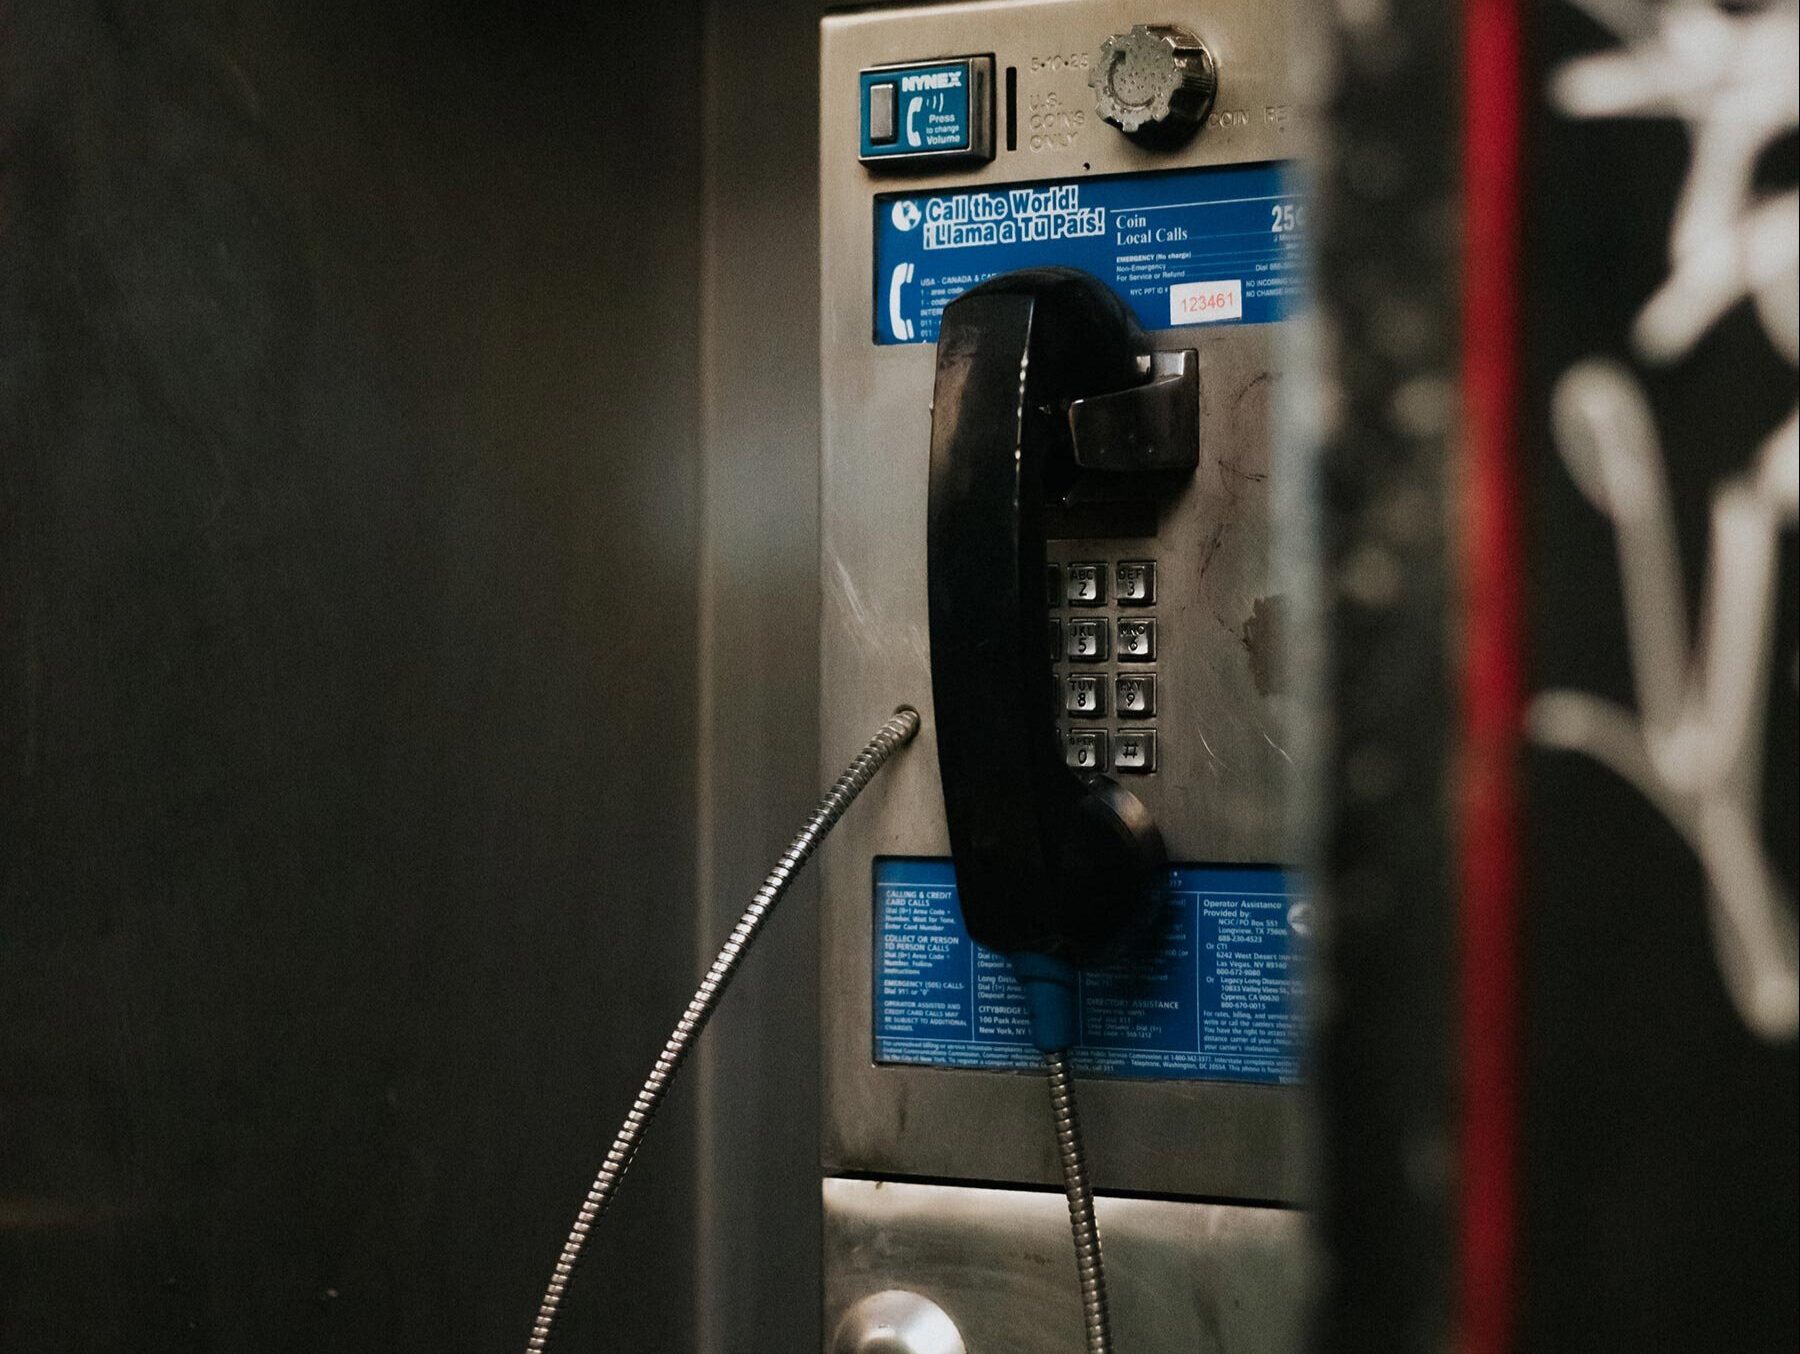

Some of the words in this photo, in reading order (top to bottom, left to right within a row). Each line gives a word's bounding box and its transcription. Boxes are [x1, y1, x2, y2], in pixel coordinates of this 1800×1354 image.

[902, 71, 962, 92] NYNEX
[928, 114, 955, 124] Press
[1208, 108, 1250, 128] COIN
[935, 124, 960, 134] change
[926, 135, 960, 146] Volume
[925, 196, 968, 223] Call
[971, 194, 1008, 220] the
[1009, 184, 1079, 218] World!
[1000, 223, 1016, 243] a
[1018, 215, 1048, 242] Tu
[1050, 208, 1106, 236] País!
[1116, 214, 1146, 230] Coin
[1116, 230, 1152, 246] Local
[1156, 227, 1188, 242] Calls
[1116, 254, 1154, 263] EMERGENCY
[1156, 254, 1166, 262] (No
[1168, 251, 1192, 260] charge)
[1116, 264, 1166, 272] Non-Emergency
[942, 276, 972, 284] CANADA
[974, 274, 979, 282] &
[1116, 274, 1127, 282] For
[1129, 273, 1152, 281] Service
[1162, 270, 1185, 278] Refund
[1246, 280, 1255, 288] NO
[1246, 290, 1255, 298] NO
[1181, 292, 1233, 313] 123461
[1070, 569, 1094, 580] ABC
[1118, 569, 1142, 580] DEF
[1078, 582, 1087, 597] 2
[1127, 581, 1136, 596] 3
[1078, 638, 1087, 652] 5
[1129, 638, 1138, 651] 6
[1070, 681, 1094, 692] TUV
[1078, 692, 1086, 707] 8
[1126, 693, 1136, 707] 9
[1122, 741, 1139, 759] #
[1078, 749, 1087, 764] 0
[886, 890, 916, 898] CALLING
[926, 891, 952, 899] CREDIT
[1204, 899, 1238, 908] Operator
[1241, 900, 1282, 909] Assistance
[1204, 909, 1237, 917] Provided
[885, 934, 915, 942] COLLECT
[930, 936, 959, 944] PERSON
[896, 943, 925, 951] PERSON
[927, 944, 949, 952] CALLS
[884, 979, 923, 987] EMERGENCY
[978, 975, 996, 984] Long
[884, 1000, 916, 1008] OPERATOR
[978, 1005, 1020, 1014] CITYBRIDGE
[1132, 1000, 1179, 1009] ASSISTANCE
[994, 1016, 1009, 1024] Park
[1244, 1028, 1257, 1036] right
